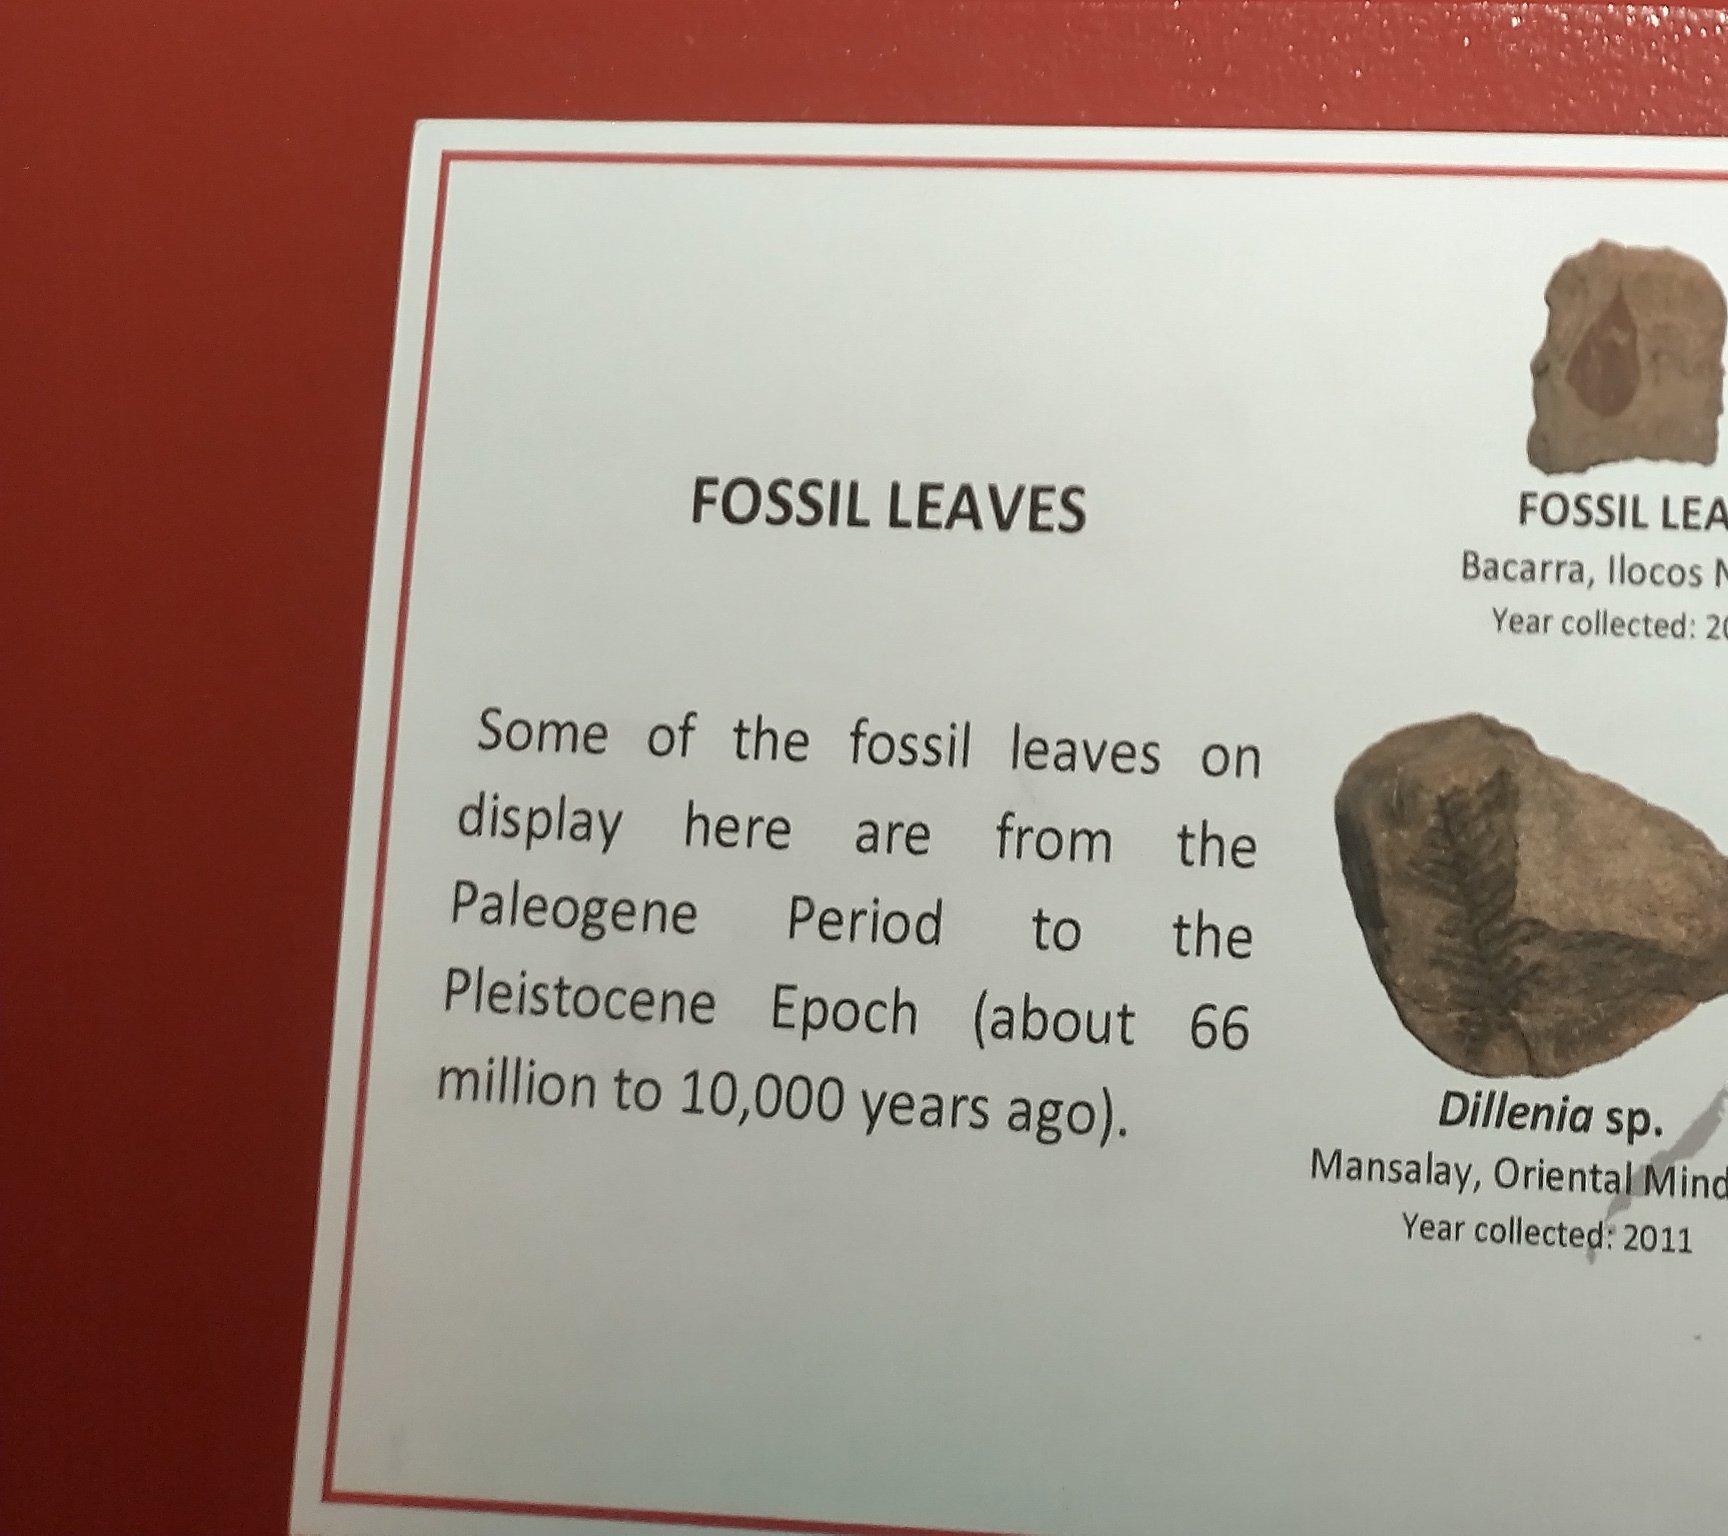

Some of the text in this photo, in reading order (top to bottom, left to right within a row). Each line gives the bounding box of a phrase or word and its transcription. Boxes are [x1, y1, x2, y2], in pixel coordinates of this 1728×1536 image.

[692, 476, 1086, 534] FOSSIL LEAVES
[1519, 491, 1649, 529] FOSSIL
[1462, 550, 1594, 589] Bacarra,
[1609, 553, 1703, 588] Ilocos
[1492, 607, 1552, 634] Year
[1561, 609, 1695, 639] collected:
[477, 707, 1260, 779] Some of the fossil leaves on
[458, 790, 1257, 869] display here are from the
[452, 879, 1253, 960] Paleogene Period to the
[445, 966, 1249, 1051] Pleistocene Epoch (about 66
[438, 1055, 1127, 1148] million to 10,000 years ago).
[1438, 1090, 1663, 1146] Dillenia sp.
[1311, 1147, 1481, 1195] Mansalay,
[1494, 1156, 1632, 1196] Oriental
[1402, 1212, 1693, 1254] Year collected: 2011
